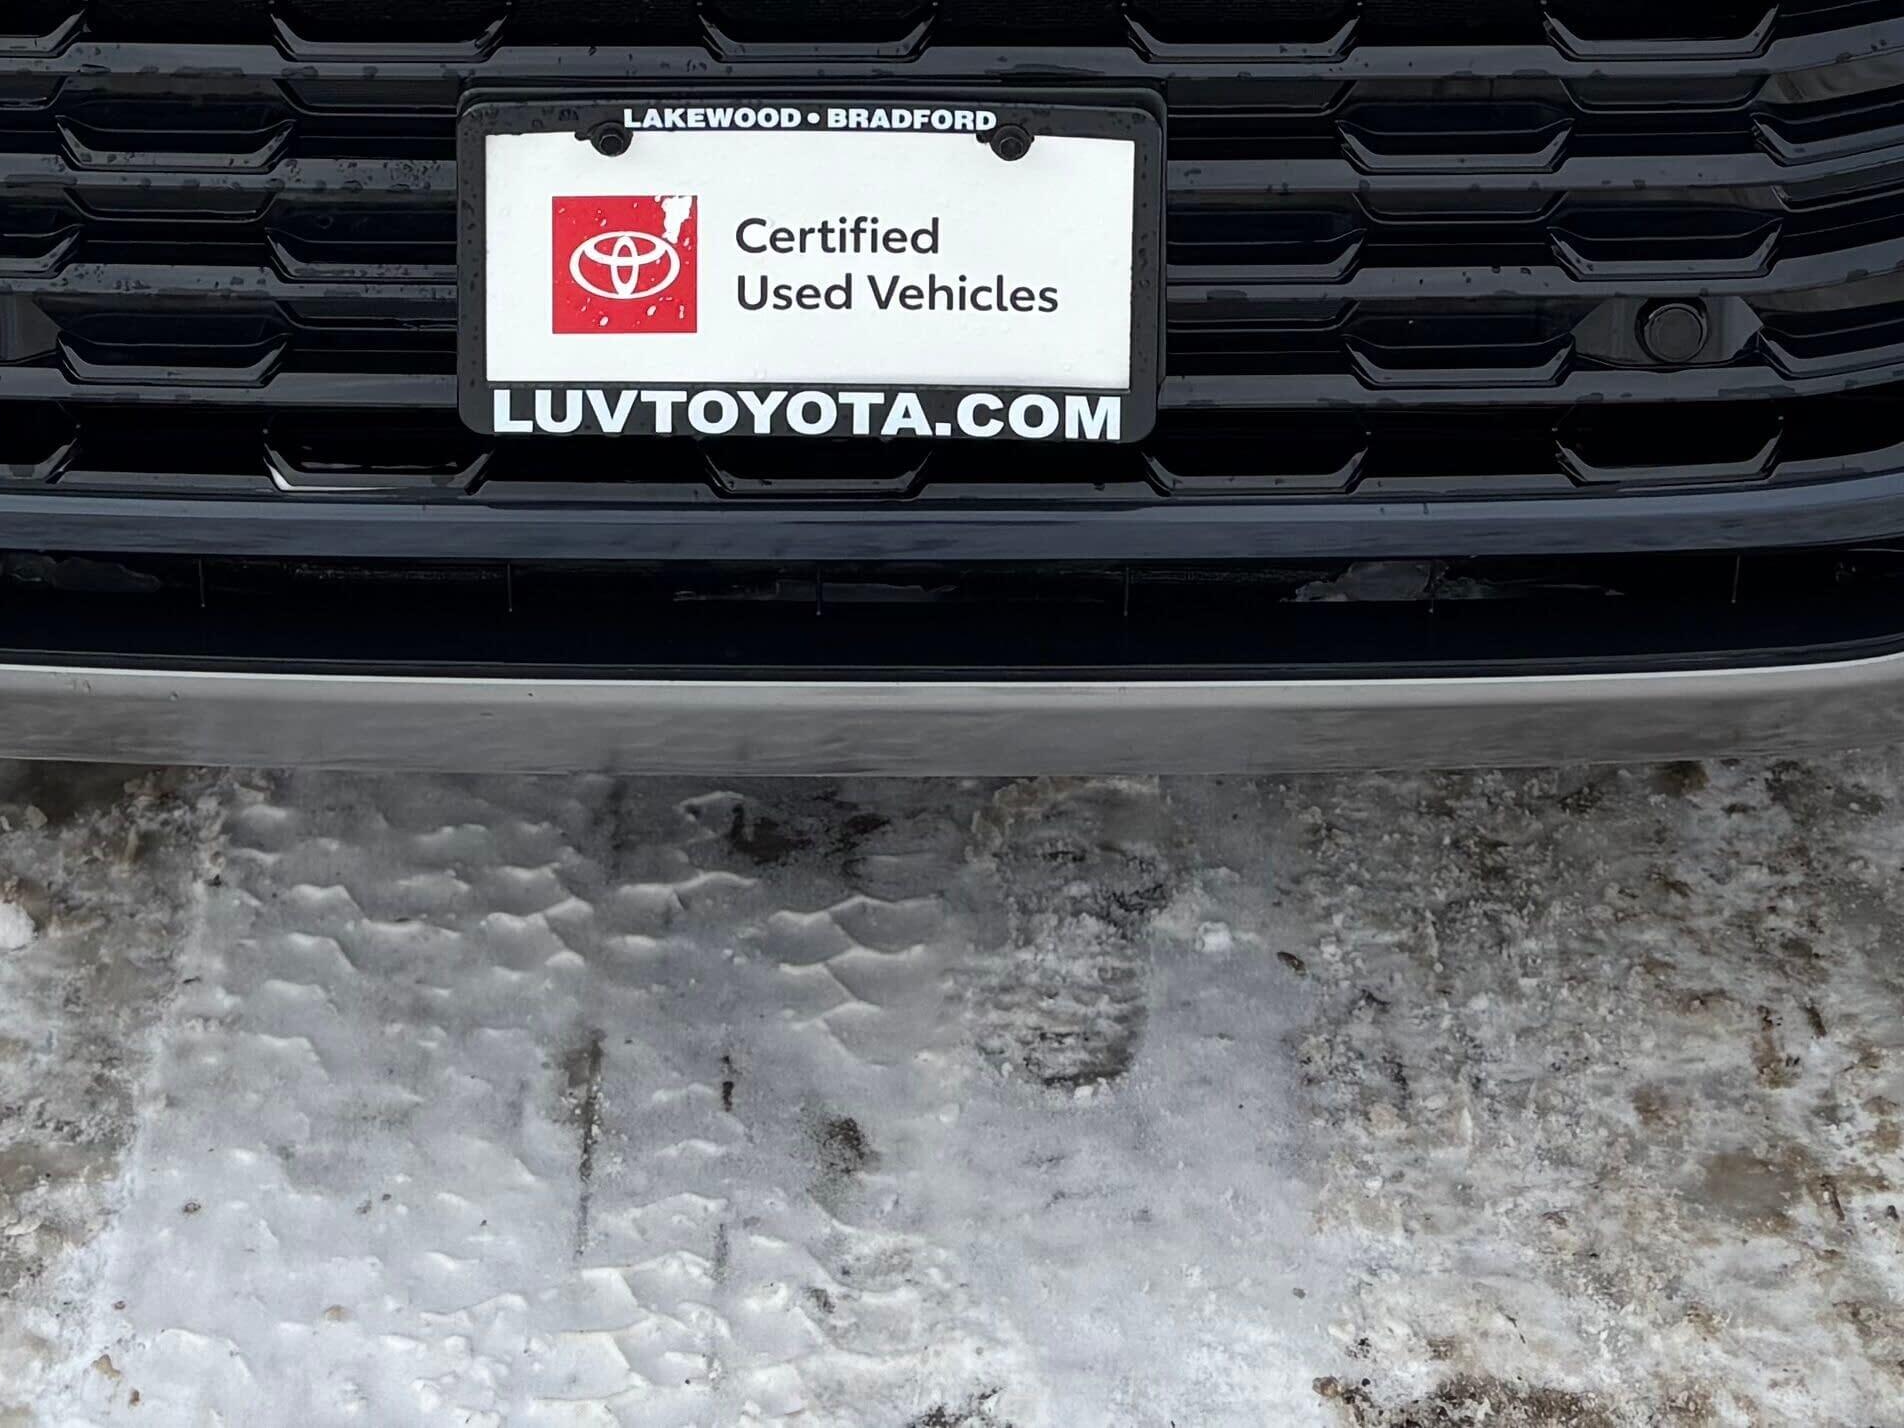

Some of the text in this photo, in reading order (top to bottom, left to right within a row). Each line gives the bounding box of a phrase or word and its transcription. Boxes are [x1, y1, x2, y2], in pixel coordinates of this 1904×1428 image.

[623, 107, 998, 131] LAKEWOOD BRADFORD
[734, 216, 940, 255] Certified
[736, 274, 1059, 313] Used Vehicles
[492, 388, 1122, 442] LUVTOYOTA.COM
